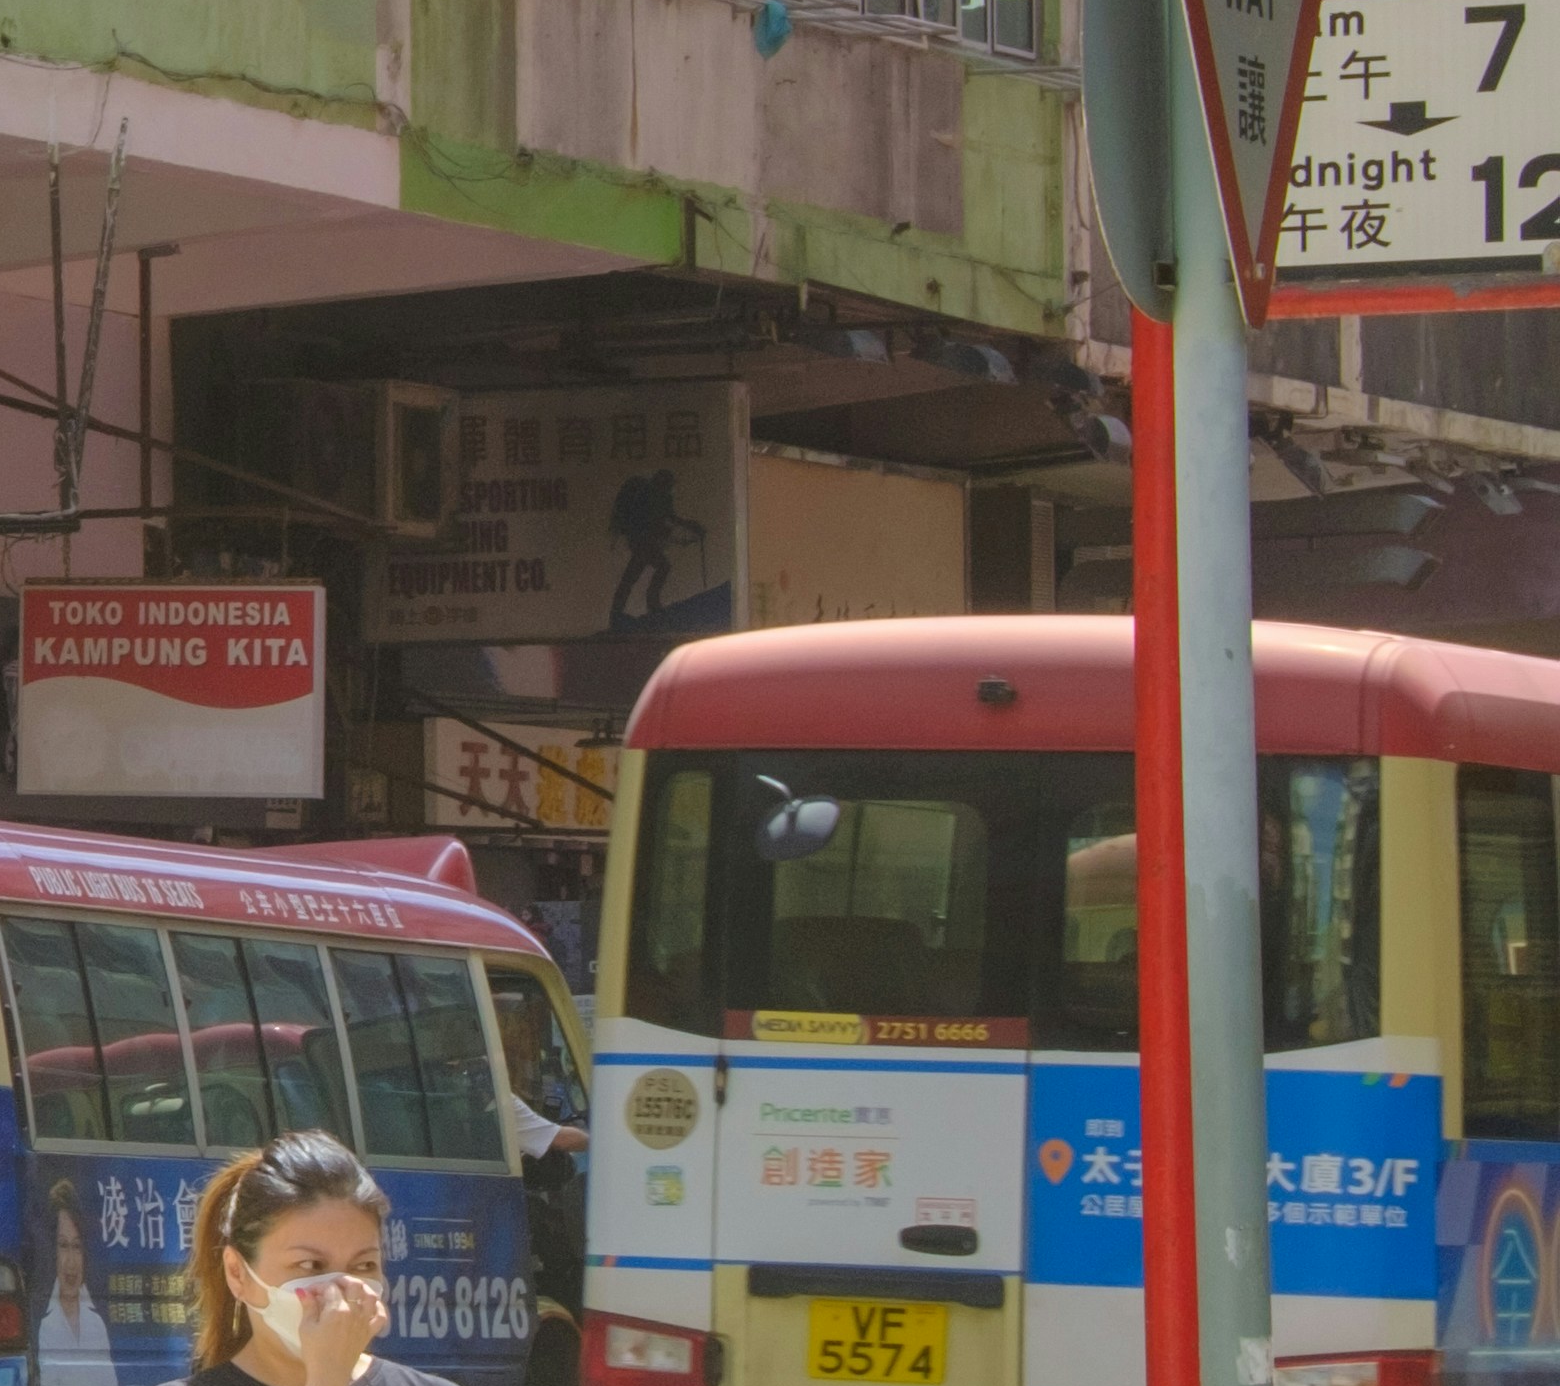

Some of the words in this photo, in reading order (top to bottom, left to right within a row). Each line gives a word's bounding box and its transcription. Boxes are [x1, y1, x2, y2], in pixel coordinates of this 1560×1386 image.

[1464, 3, 1525, 93] 7
[1237, 54, 1267, 147] 讓
[1288, 148, 1437, 190] dnight
[388, 561, 510, 599] EQUIPMENT
[49, 600, 123, 626] TOKO
[138, 601, 291, 627] INDONESIA
[34, 637, 207, 666] KAMPUNG
[227, 638, 309, 667] KITA
[29, 865, 82, 898] PUBLIC
[81, 870, 120, 901] LIGHT
[160, 879, 205, 910] SEATS
[877, 1022, 928, 1040] 2751
[935, 1023, 990, 1042] 6666
[759, 1102, 853, 1124] Pricerite
[761, 1145, 894, 1190] 創造家
[454, 1275, 530, 1340] 8126
[850, 1309, 905, 1341] VF
[817, 1340, 935, 1380] 5574
